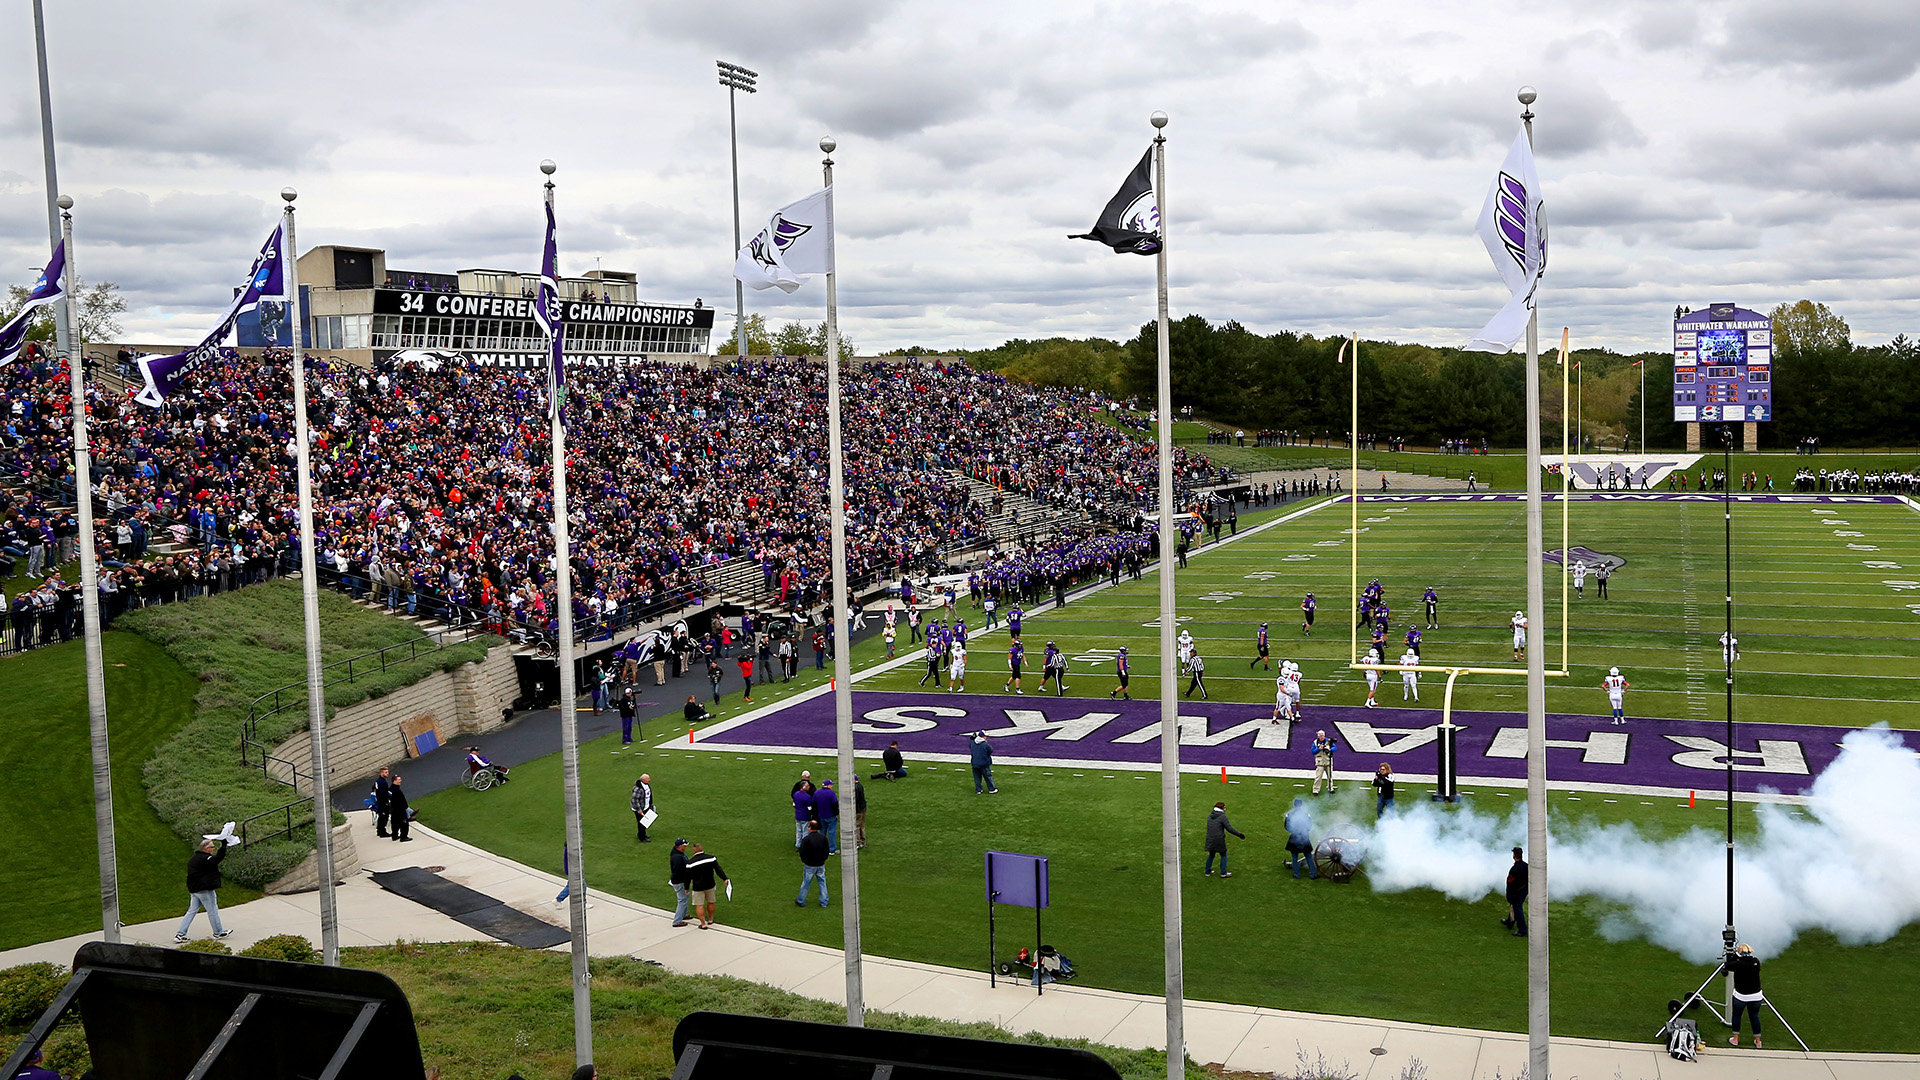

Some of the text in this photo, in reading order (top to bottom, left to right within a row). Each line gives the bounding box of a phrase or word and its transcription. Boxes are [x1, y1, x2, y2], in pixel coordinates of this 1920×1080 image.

[400, 293, 424, 312] 34
[436, 295, 563, 318] CONFEREN
[569, 303, 694, 325] CHAMPIONSHIPS
[1676, 320, 1769, 331] WHITEWATER WARHAWKS
[471, 353, 642, 368] WHITWATER
[1547, 464, 1561, 474] 25
[1289, 673, 1299, 683] 43
[1612, 679, 1620, 687] 11
[850, 704, 1920, 776] RHAWKS
